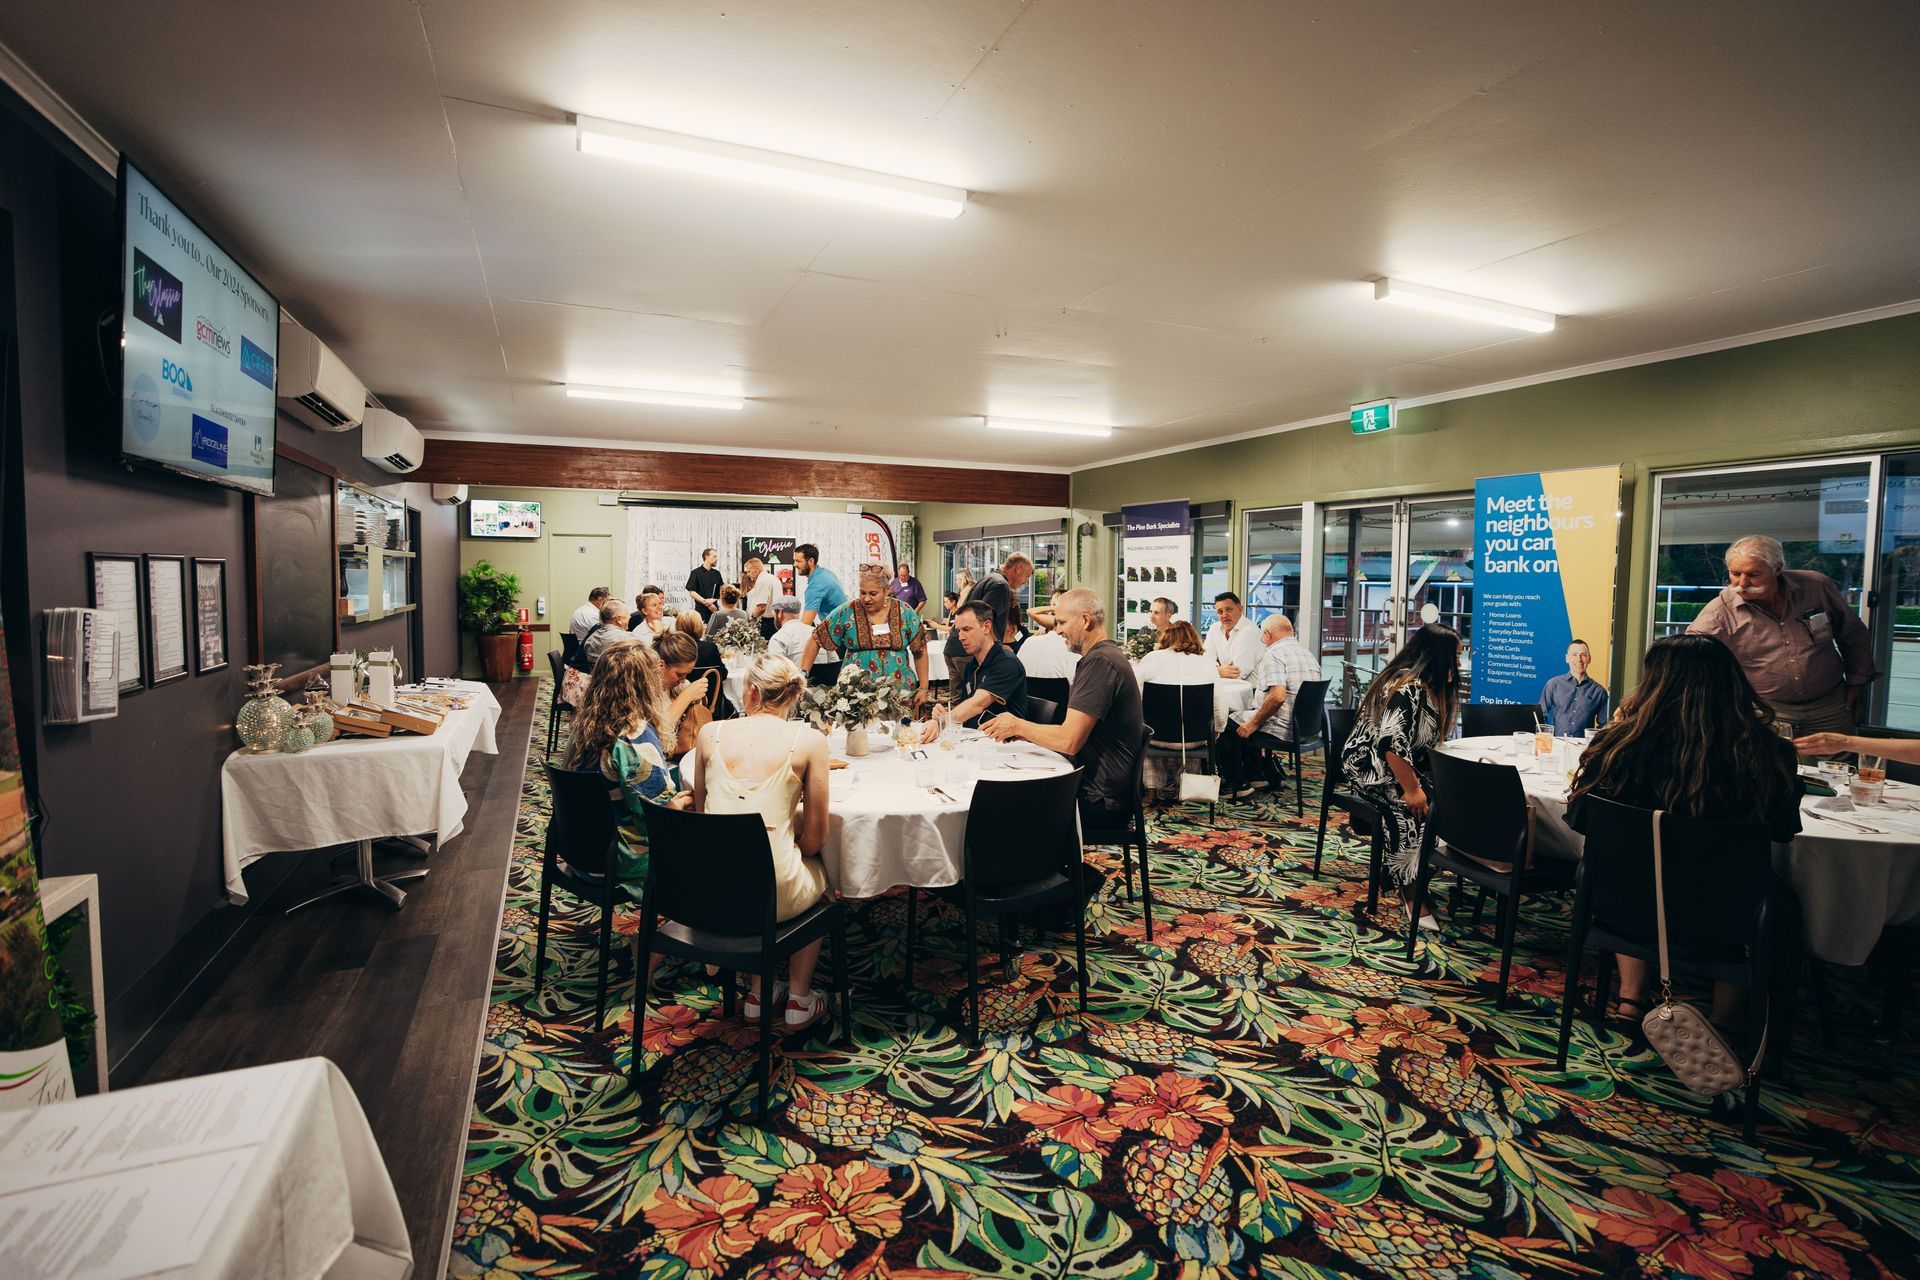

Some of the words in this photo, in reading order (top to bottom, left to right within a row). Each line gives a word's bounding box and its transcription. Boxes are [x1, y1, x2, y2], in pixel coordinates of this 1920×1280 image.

[138, 192, 171, 239] Thank
[171, 228, 190, 255] you
[206, 254, 221, 281] Our
[222, 269, 240, 297] 2024
[240, 285, 269, 322] Sponsors
[162, 358, 186, 388] BOQ
[1486, 495, 1536, 514] Meet
[1538, 492, 1573, 511] the
[1485, 513, 1595, 536] neighbours
[745, 537, 761, 552] The
[759, 539, 793, 557] Glassie
[1484, 538, 1519, 556] you
[1521, 536, 1556, 551] can
[1484, 555, 1531, 573] bank
[1532, 559, 1558, 573] on
[1488, 619, 1511, 627] Personal
[1488, 628, 1512, 636] Everyday
[1512, 629, 1535, 637] Banking
[1508, 637, 1533, 645] Accounts
[1488, 652, 1510, 660] Business
[1510, 653, 1533, 663] Banking
[1487, 660, 1519, 669] Commercial
[1487, 668, 1515, 677] Equipment
[1515, 670, 1537, 679] Finance
[1487, 677, 1513, 685] Insurance
[1480, 695, 1495, 705] Pop
[1495, 696, 1503, 705] in
